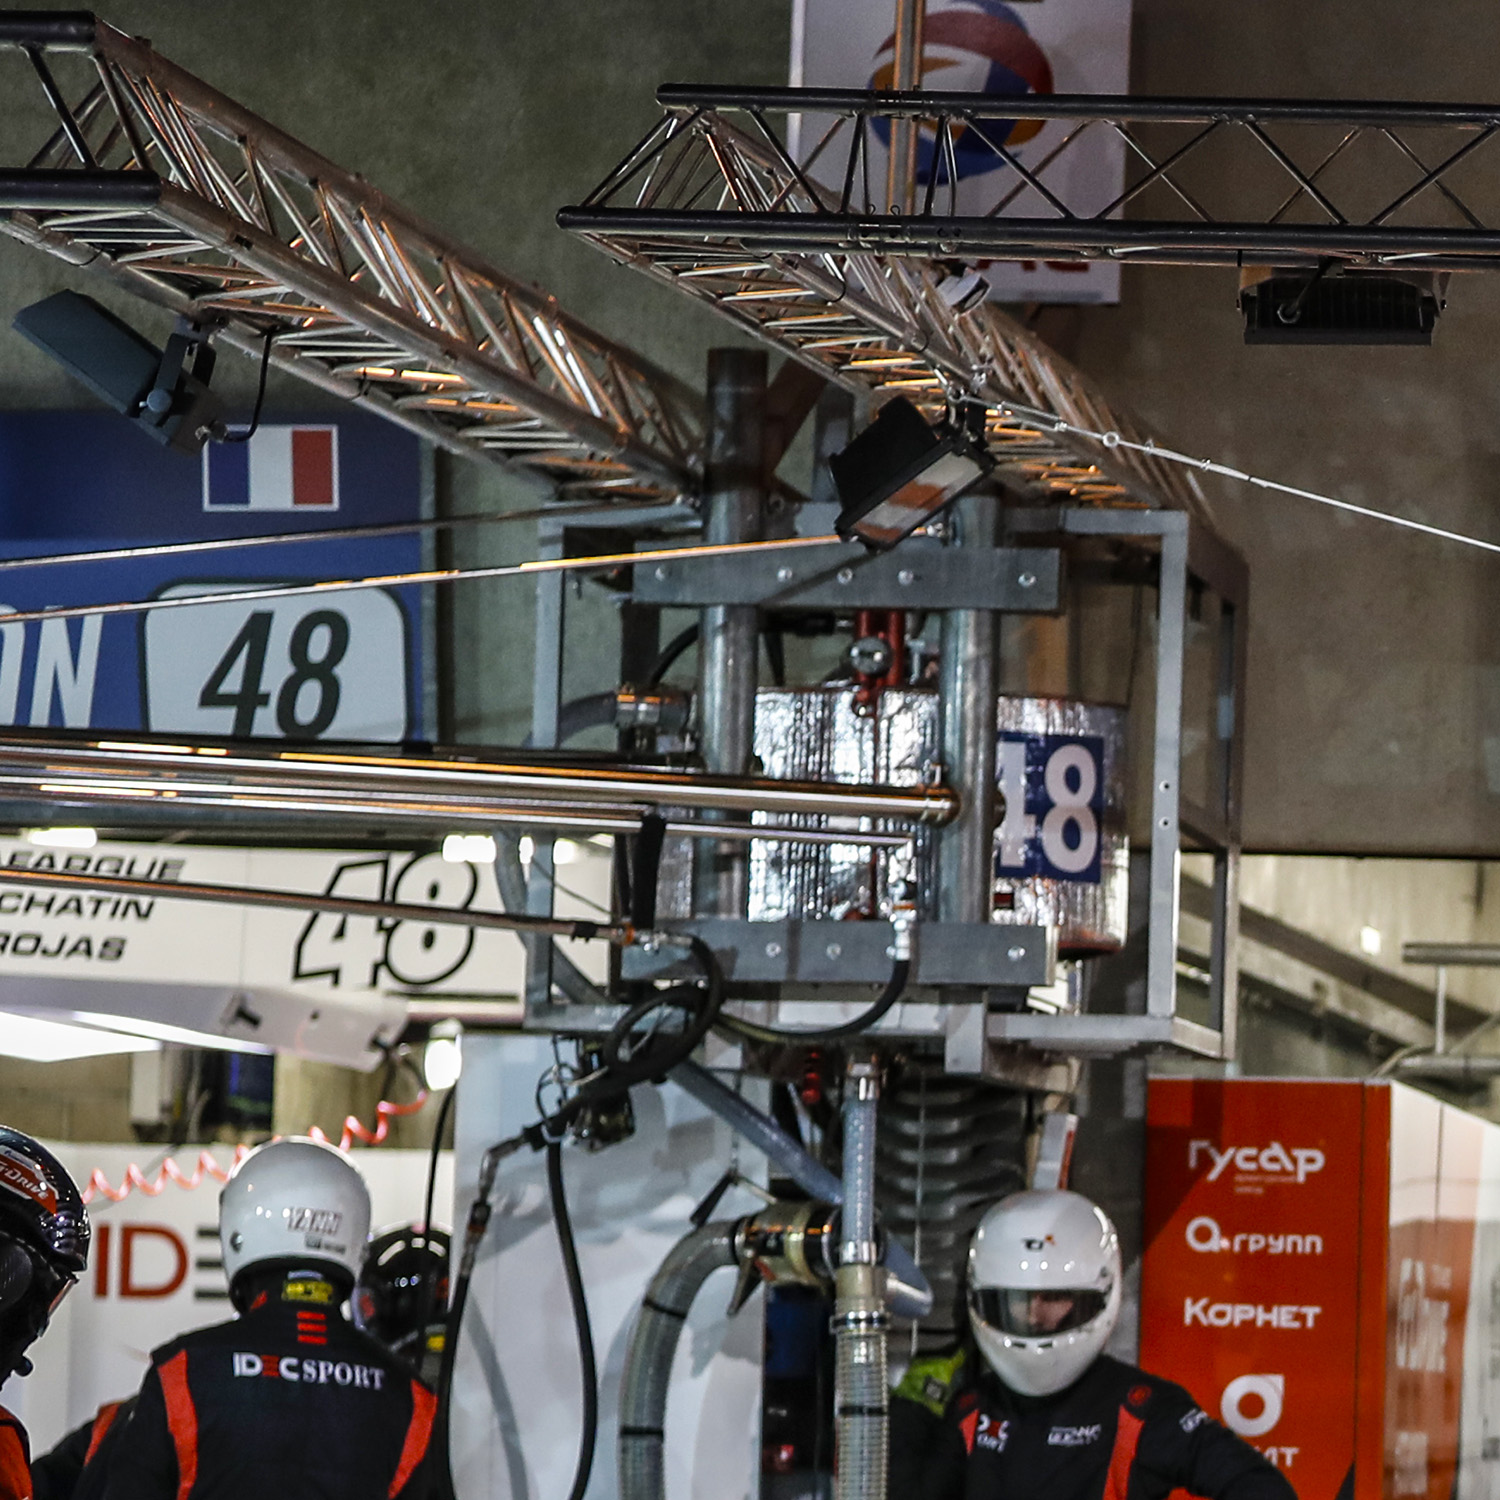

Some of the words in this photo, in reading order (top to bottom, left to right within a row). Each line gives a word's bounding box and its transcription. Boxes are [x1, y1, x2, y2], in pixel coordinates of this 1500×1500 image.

[198, 609, 351, 740] 48
[292, 851, 479, 987] 48
[302, 1359, 386, 1391] SPORT
